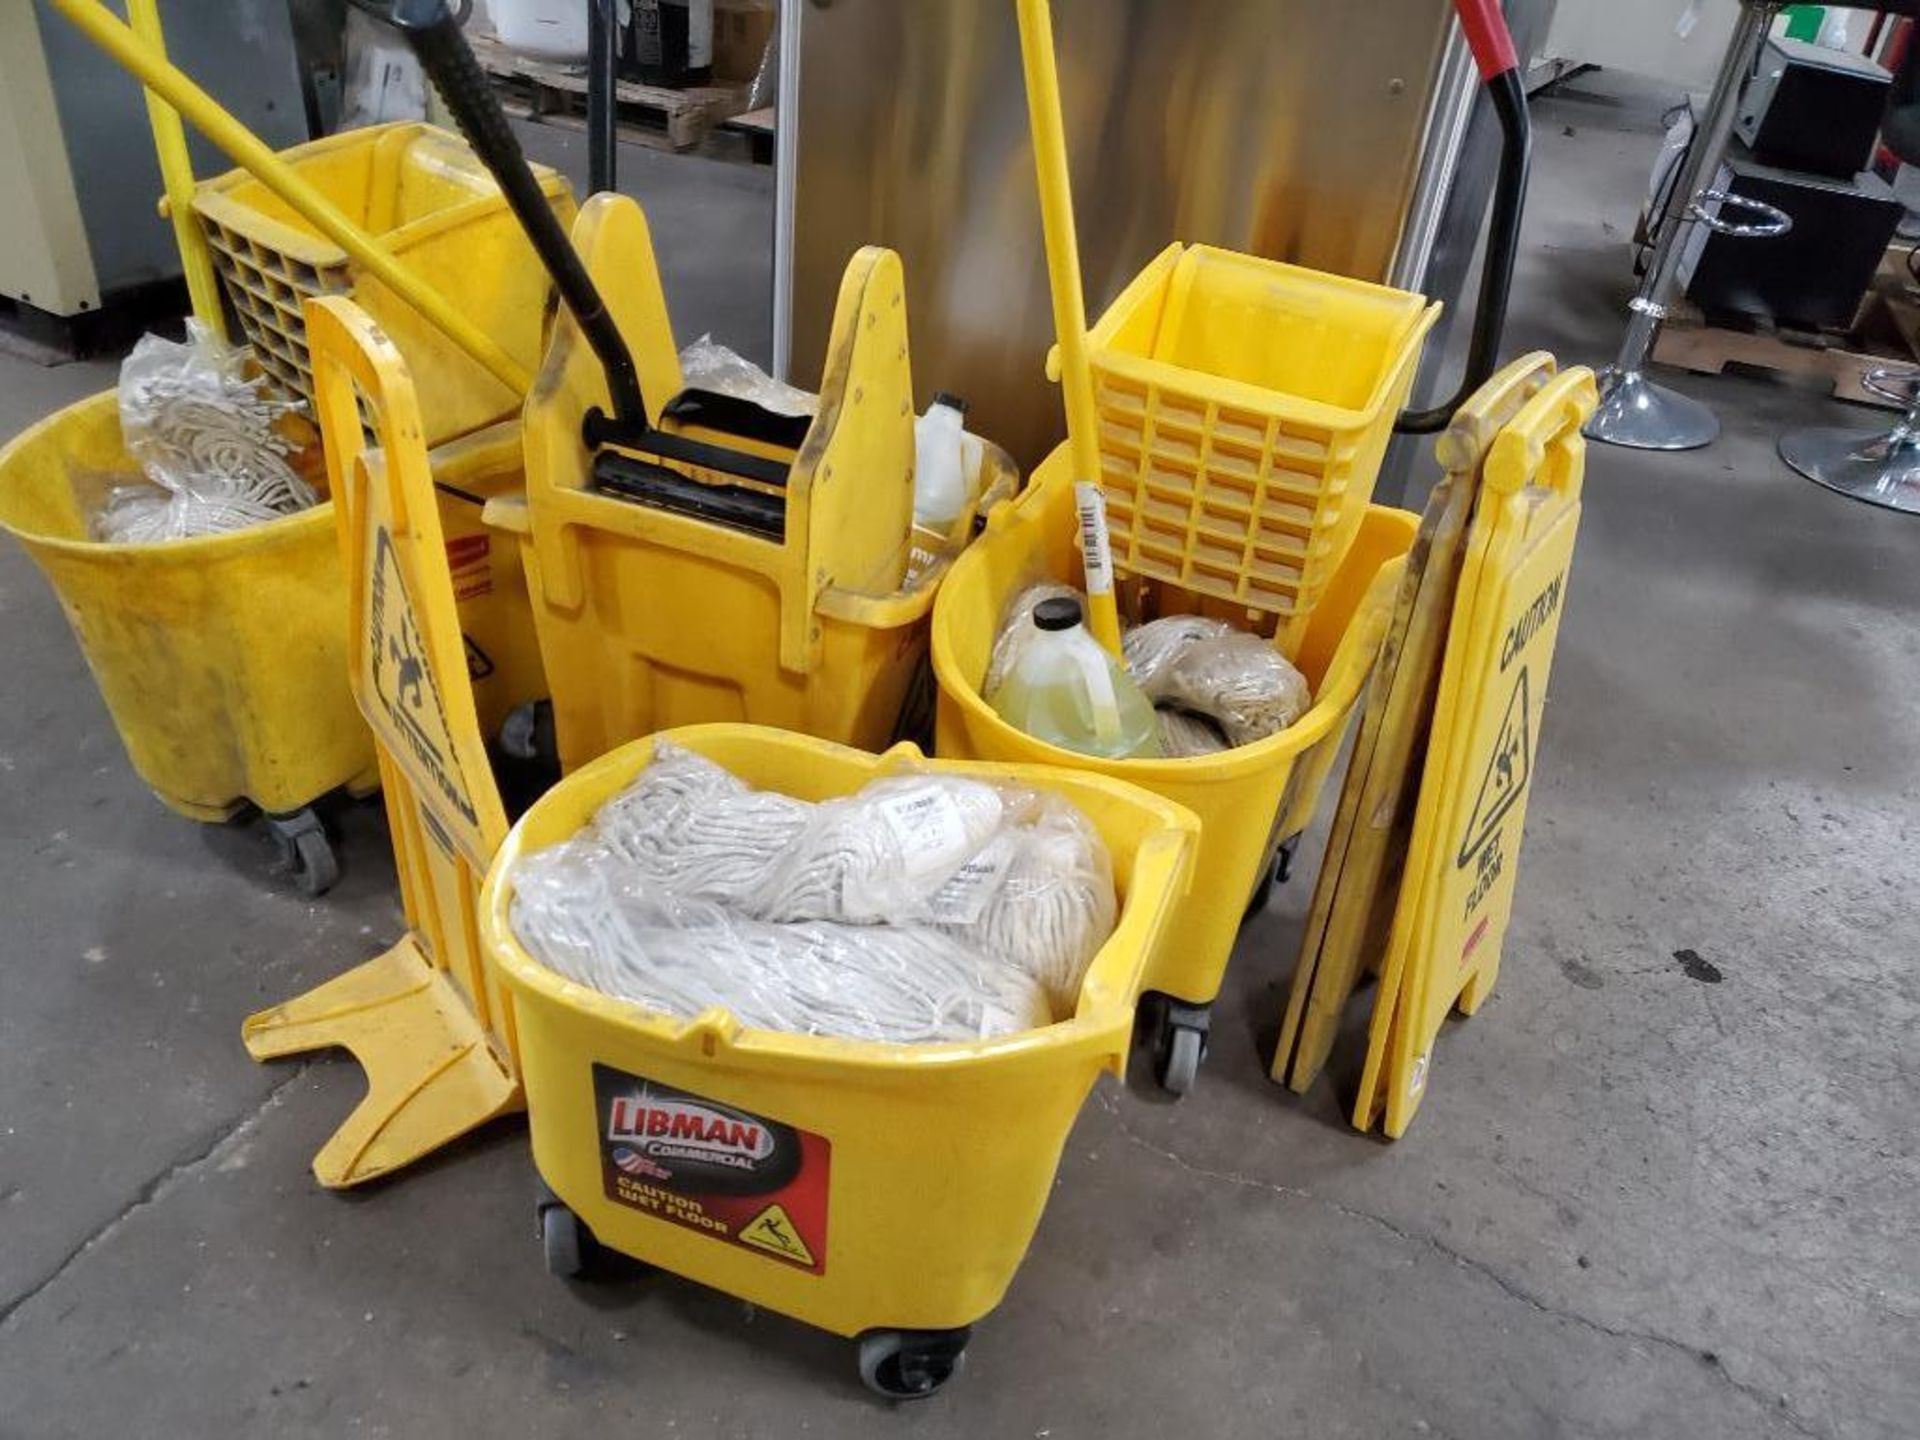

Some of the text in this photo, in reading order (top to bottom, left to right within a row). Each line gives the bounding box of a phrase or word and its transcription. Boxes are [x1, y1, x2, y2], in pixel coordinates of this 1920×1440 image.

[1500, 571, 1564, 673] CAUTION
[1477, 827, 1502, 879] WET
[1464, 851, 1503, 921] FLOOR
[612, 1099, 760, 1151] LIBMAN
[648, 1142, 757, 1171] COMMERCIAL
[617, 1176, 703, 1214] CAUTION
[618, 1186, 729, 1234] WET FLOOR
